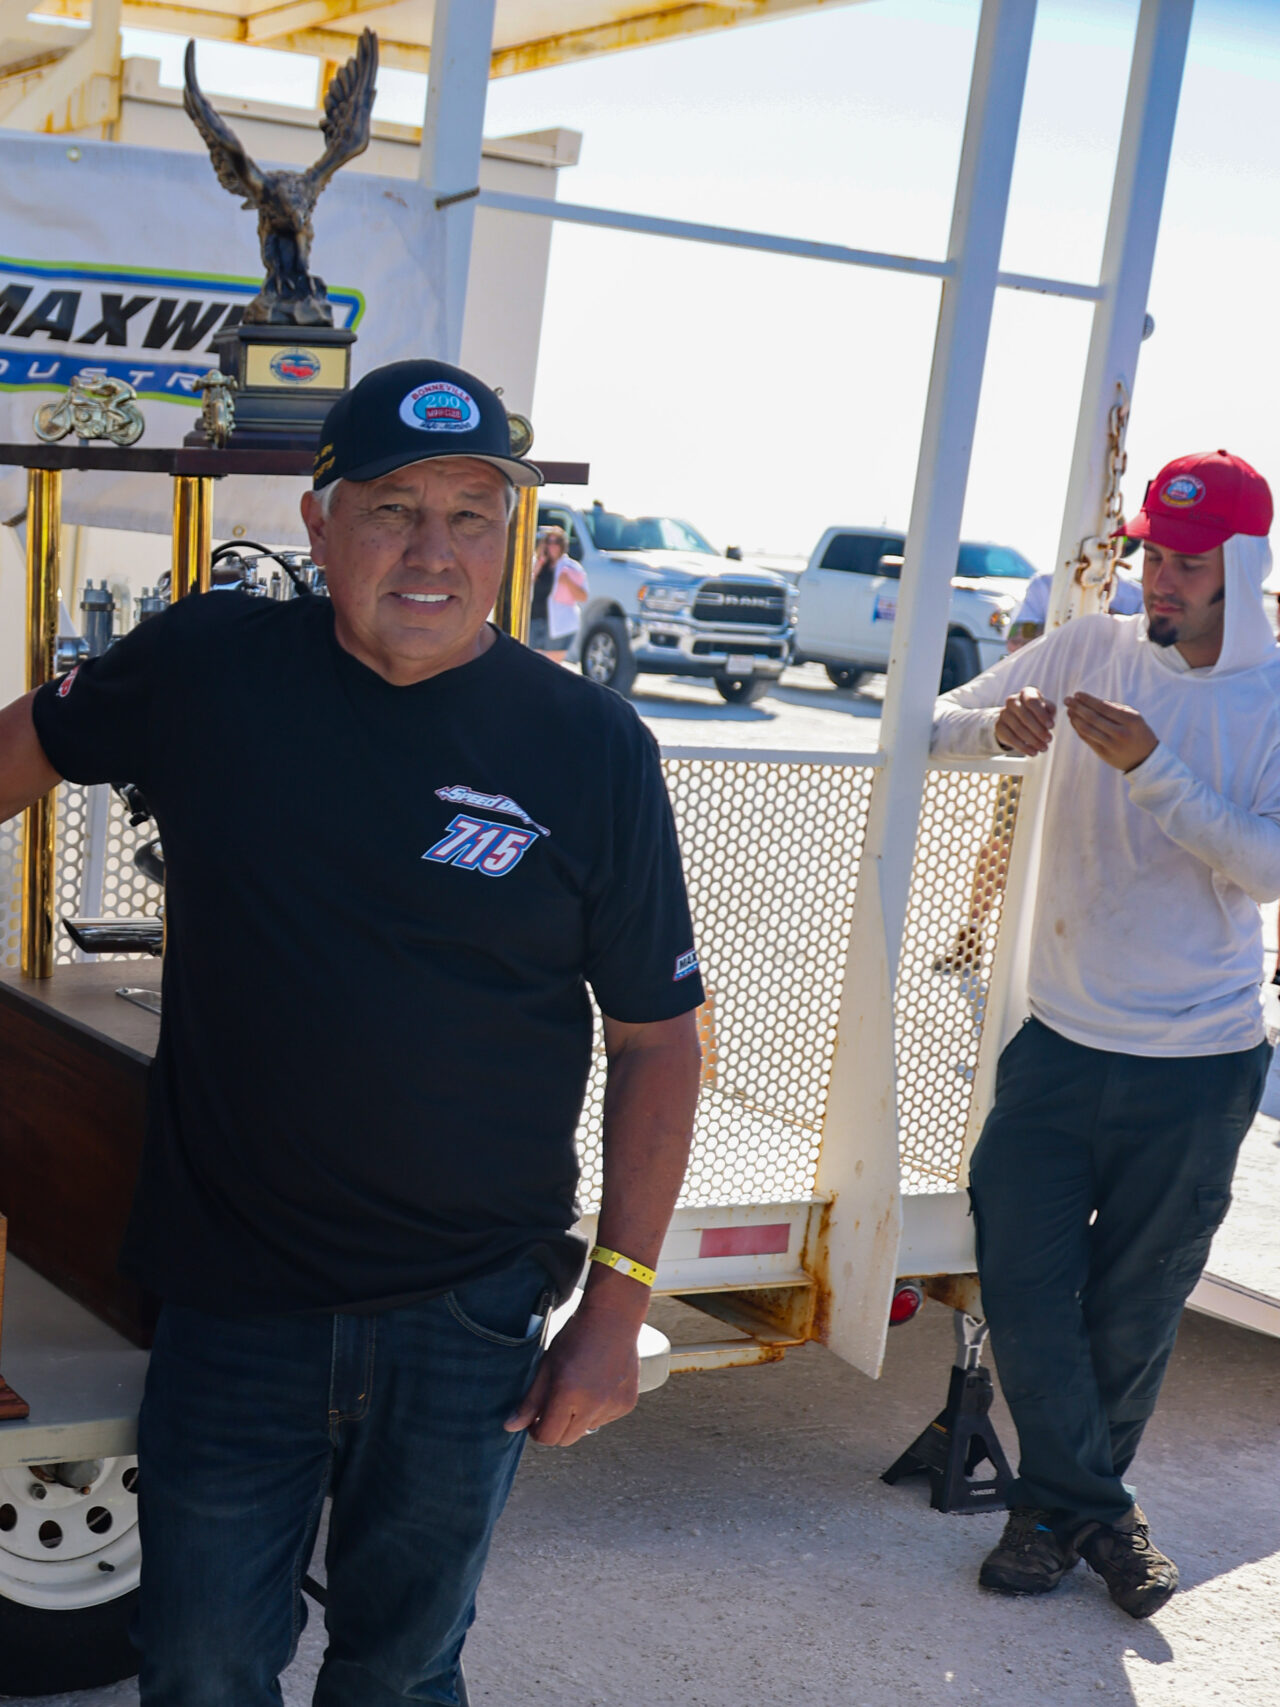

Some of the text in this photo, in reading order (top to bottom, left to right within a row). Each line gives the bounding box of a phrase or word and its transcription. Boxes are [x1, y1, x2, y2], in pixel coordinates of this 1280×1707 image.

[411, 384, 471, 402] BONNEVILLE
[425, 394, 461, 408] 200
[426, 816, 535, 874] 715
